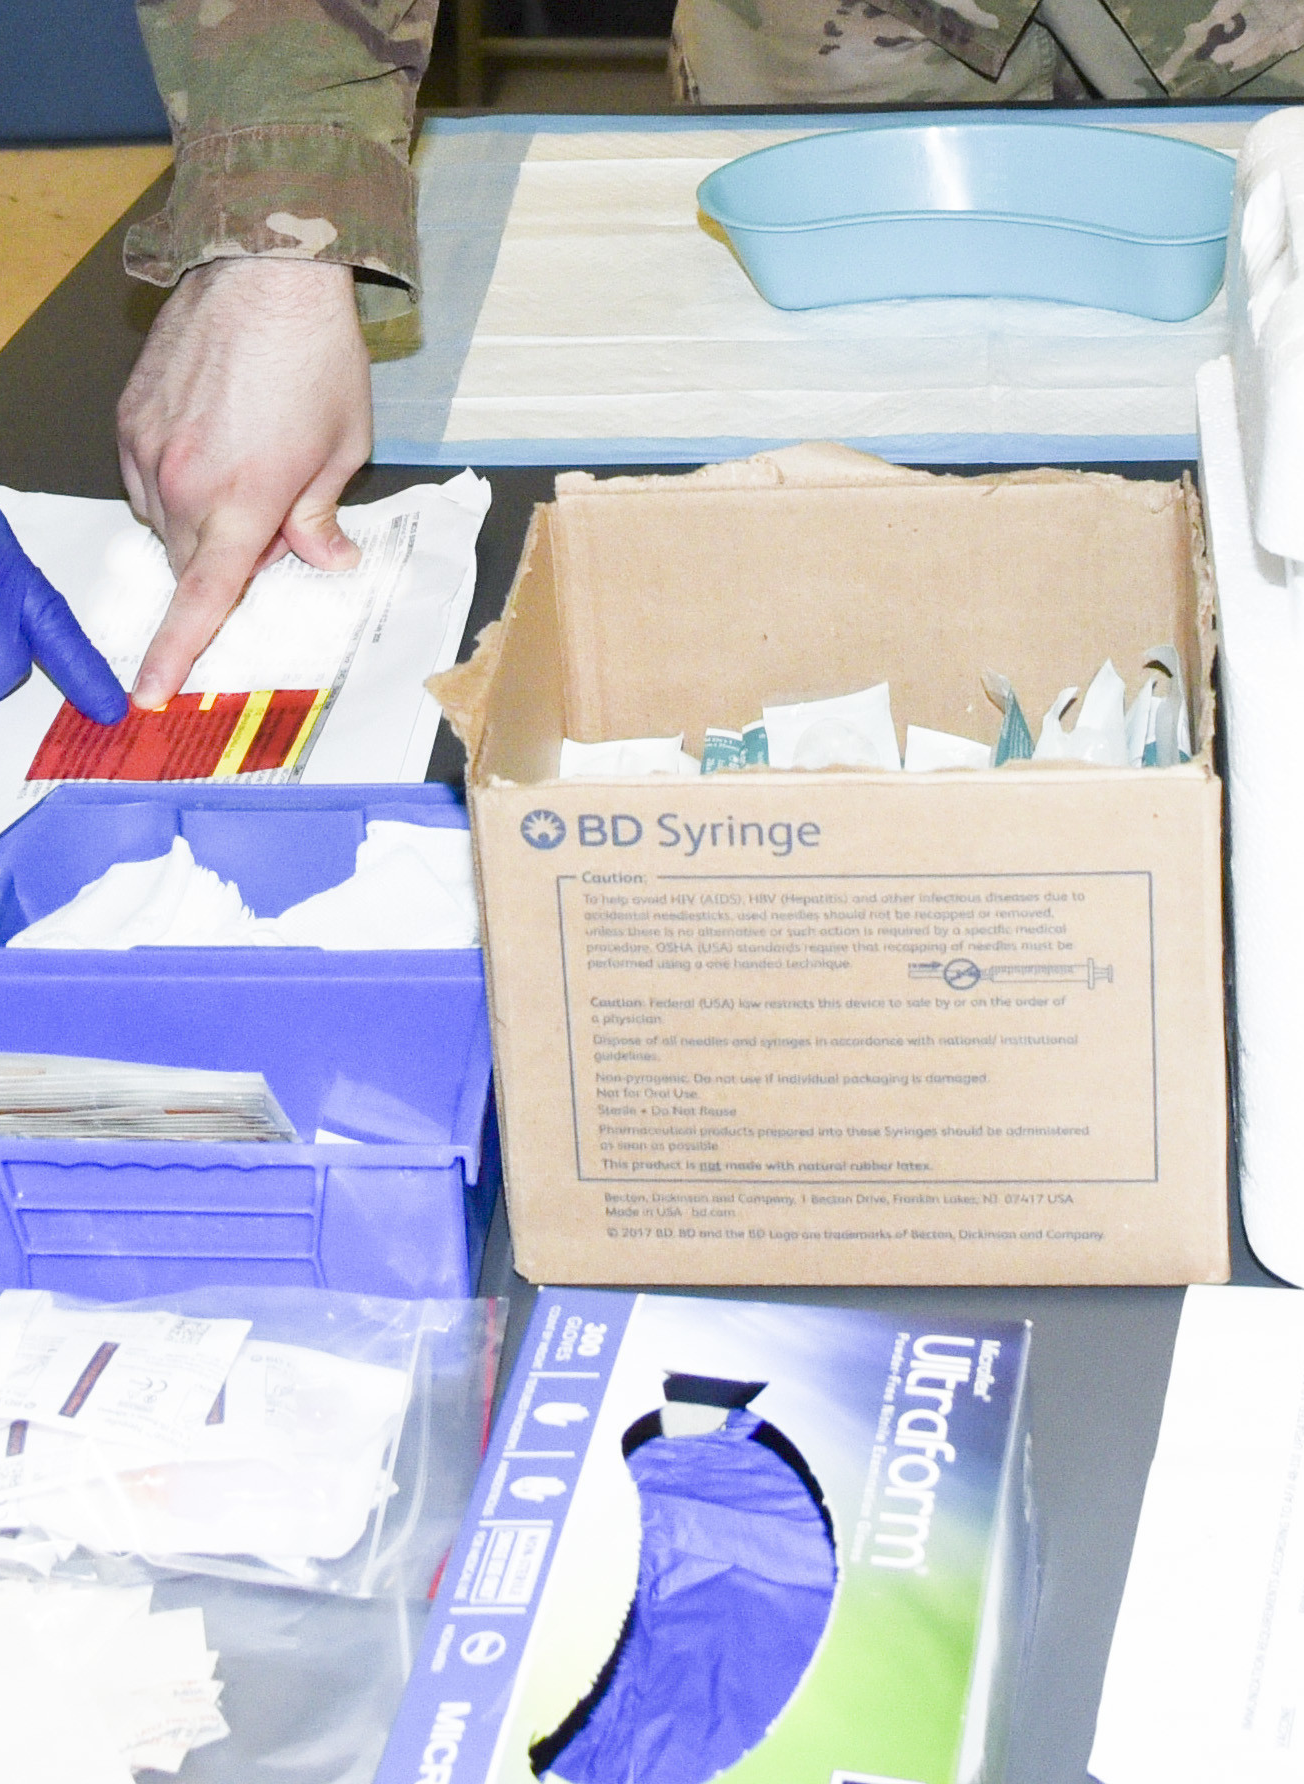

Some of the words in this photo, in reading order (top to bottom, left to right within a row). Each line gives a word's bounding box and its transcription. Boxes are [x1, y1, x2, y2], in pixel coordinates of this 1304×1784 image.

[577, 813, 643, 848] BD
[657, 812, 823, 856] Syringe
[601, 1158, 629, 1170] This
[631, 1158, 682, 1173] product
[725, 1159, 763, 1171] made
[765, 1159, 795, 1171] with
[797, 1160, 847, 1172] natural
[850, 1160, 893, 1172] rubber
[1047, 1193, 1074, 1205] USA
[555, 1315, 583, 1362] GLOVES
[577, 1322, 608, 1357] 300
[870, 1334, 975, 1570] Ultraform
